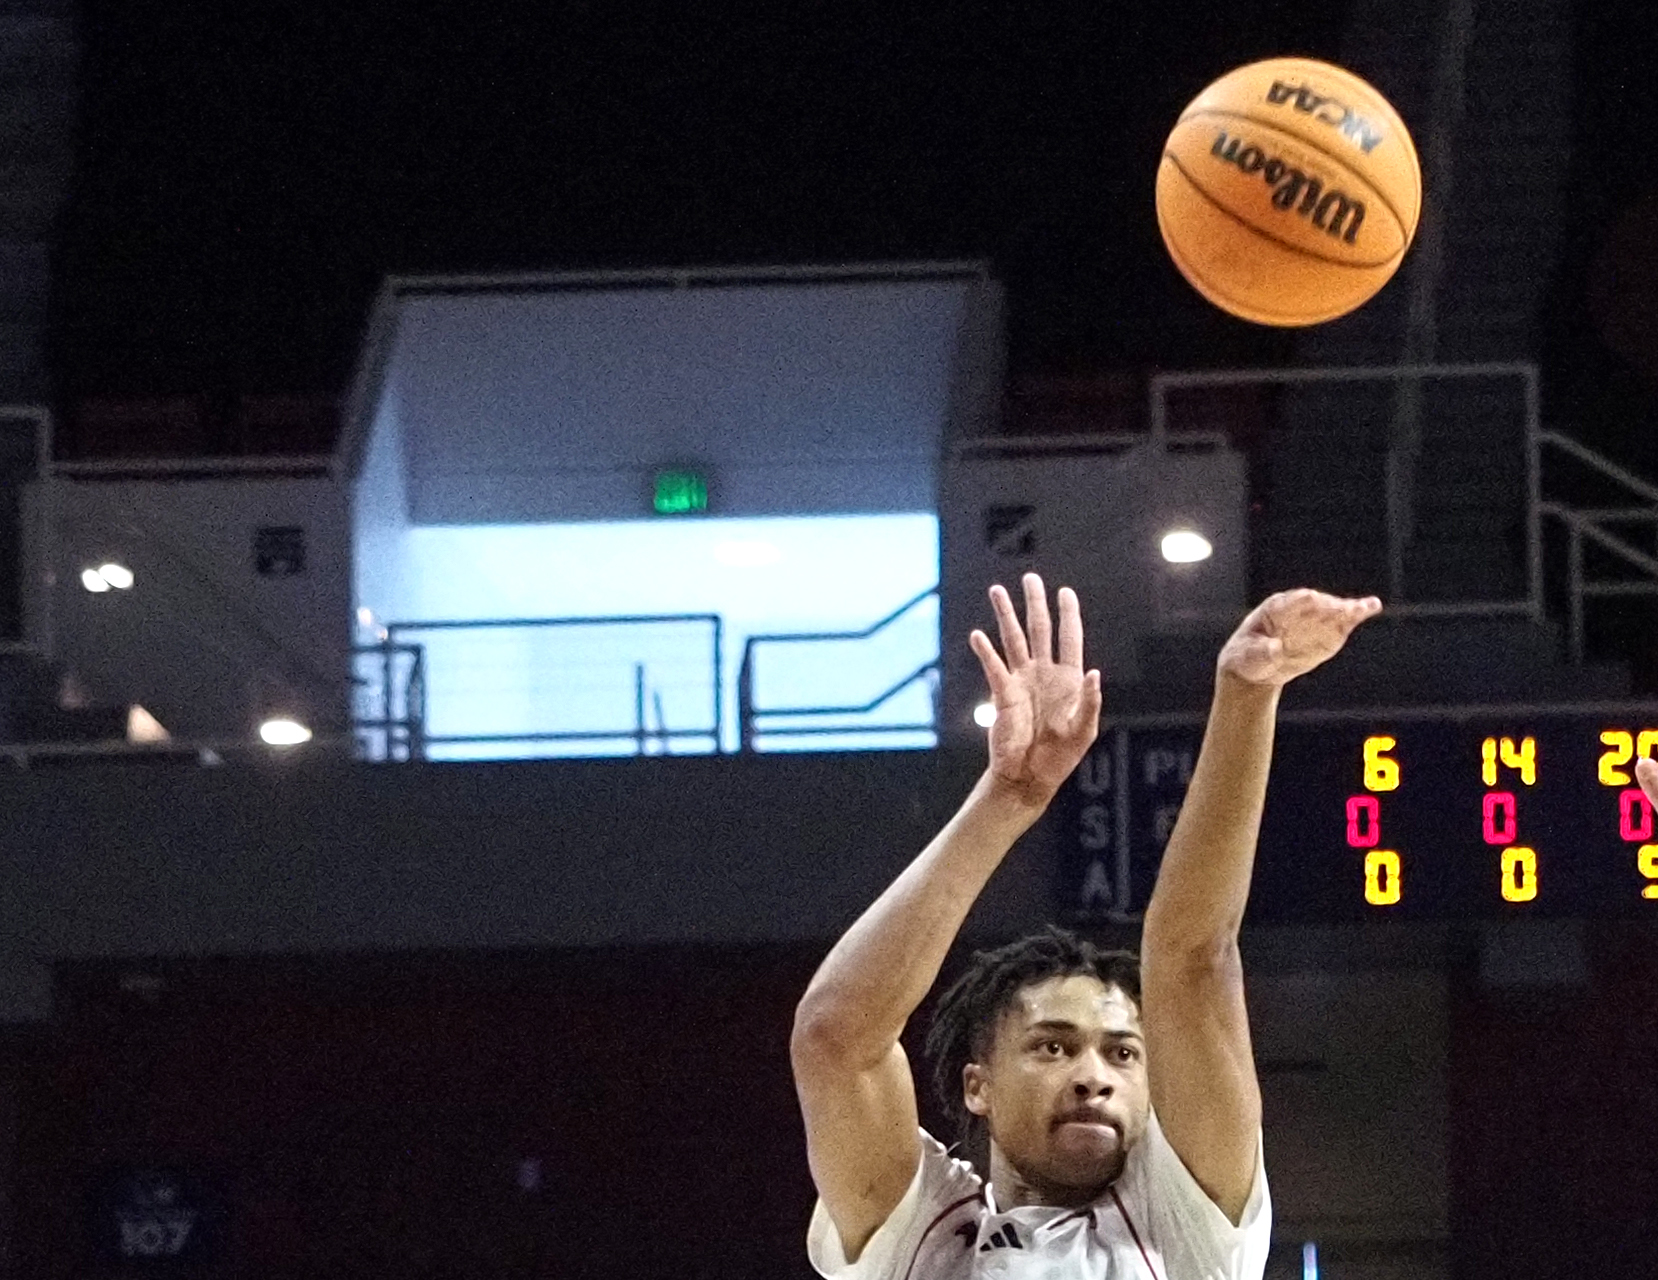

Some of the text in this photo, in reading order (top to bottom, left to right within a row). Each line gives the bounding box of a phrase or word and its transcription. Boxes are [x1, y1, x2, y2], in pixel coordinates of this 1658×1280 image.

[1265, 79, 1384, 154] NCAA
[1210, 131, 1367, 245] Wilson
[1363, 736, 1400, 792] 6
[1481, 736, 1537, 786] 14
[1346, 794, 1381, 848] 0
[1482, 791, 1517, 845] 0
[1619, 788, 1653, 842] 0
[1364, 850, 1401, 906] 0
[1501, 846, 1538, 903] 0
